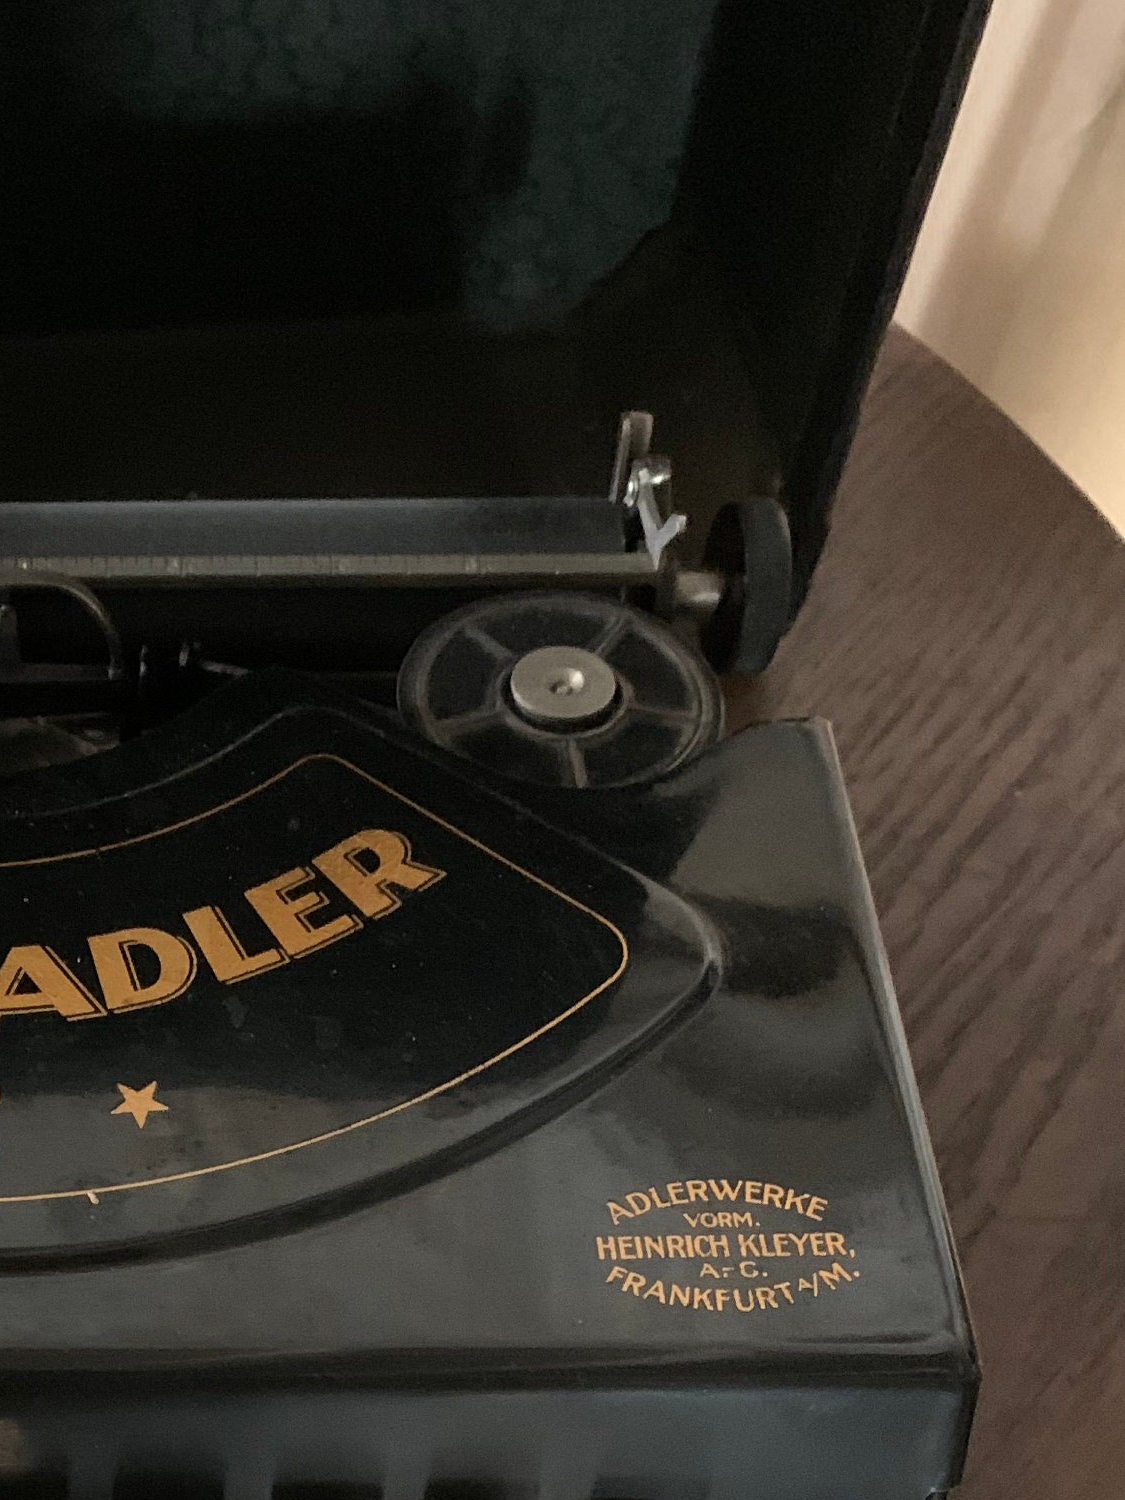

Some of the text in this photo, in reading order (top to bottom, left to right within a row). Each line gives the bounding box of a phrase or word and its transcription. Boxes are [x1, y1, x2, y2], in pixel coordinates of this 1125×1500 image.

[606, 1179, 828, 1226] ADLERWERKE
[683, 1211, 761, 1228] VORM.
[596, 1231, 856, 1261] HEINRICH KLEYER,
[605, 1265, 795, 1313] FRANKFURT
